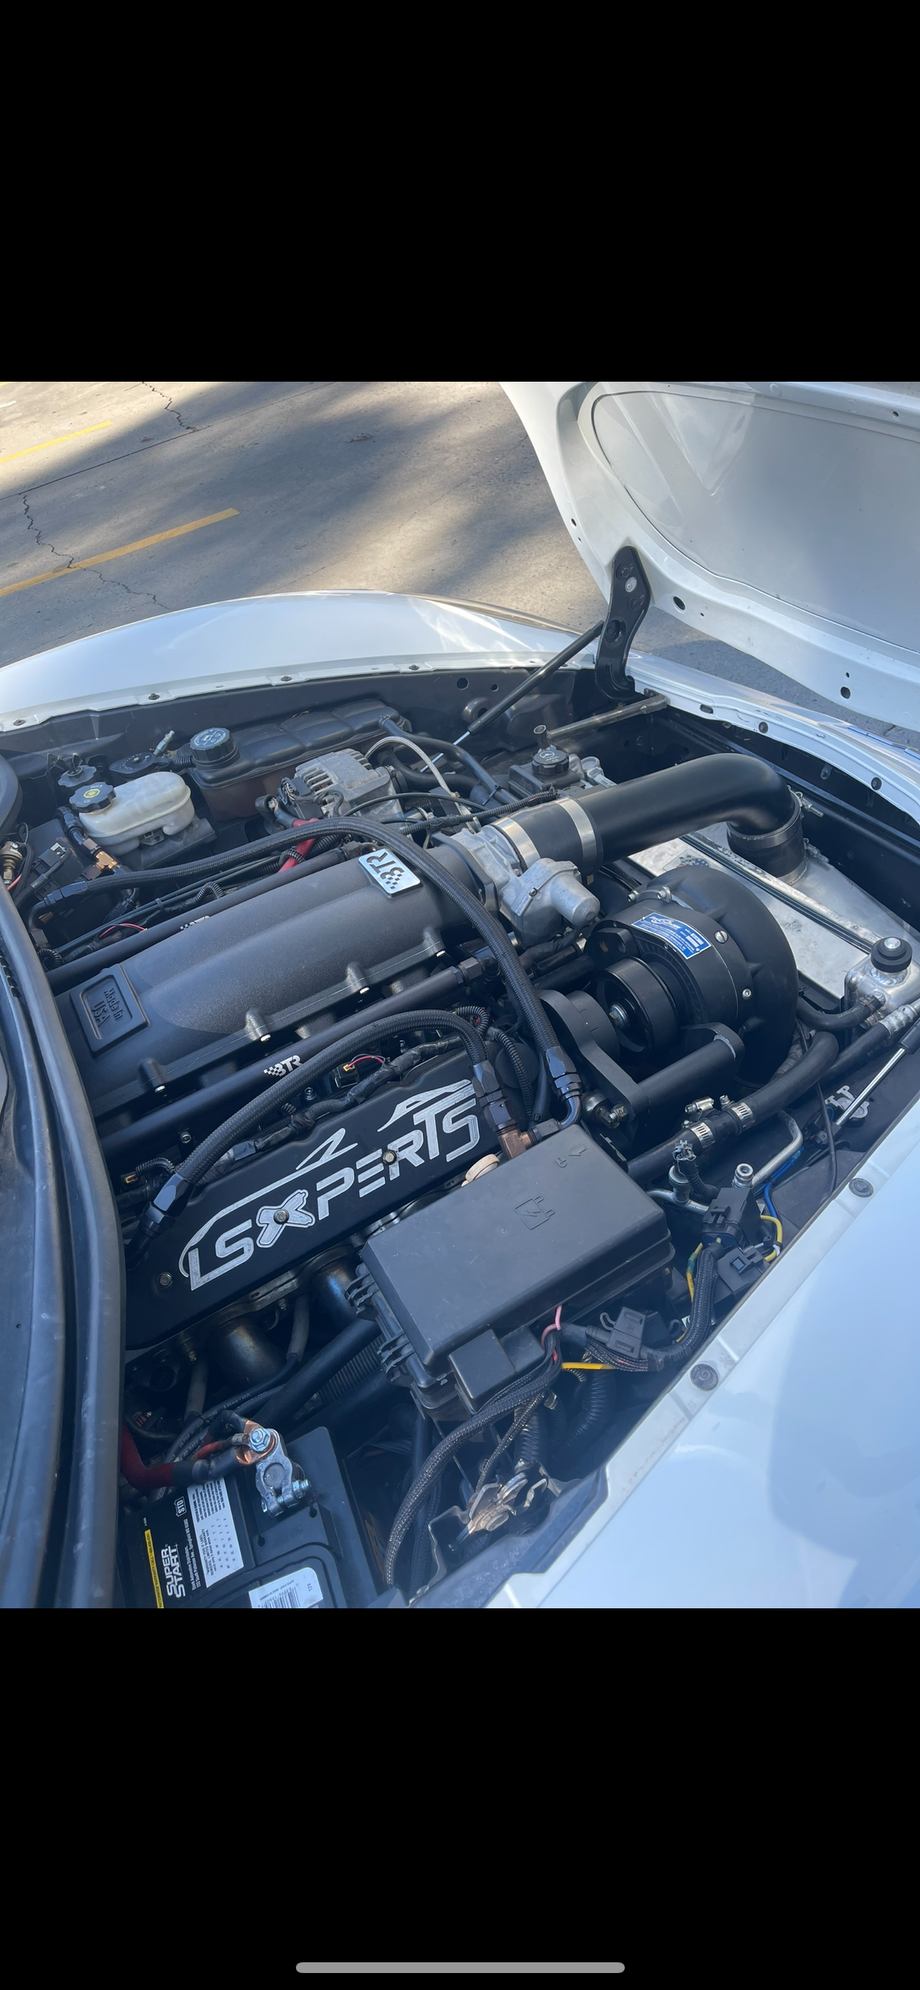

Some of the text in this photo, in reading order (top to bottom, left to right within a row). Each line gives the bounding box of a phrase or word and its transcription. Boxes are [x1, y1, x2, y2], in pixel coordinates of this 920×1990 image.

[366, 852, 405, 889] BTR
[91, 1000, 111, 1027] USA
[104, 988, 120, 1011] Made
[264, 1054, 302, 1076] BTR
[161, 1549, 175, 1596] SUPER
[168, 1546, 186, 1598] START
